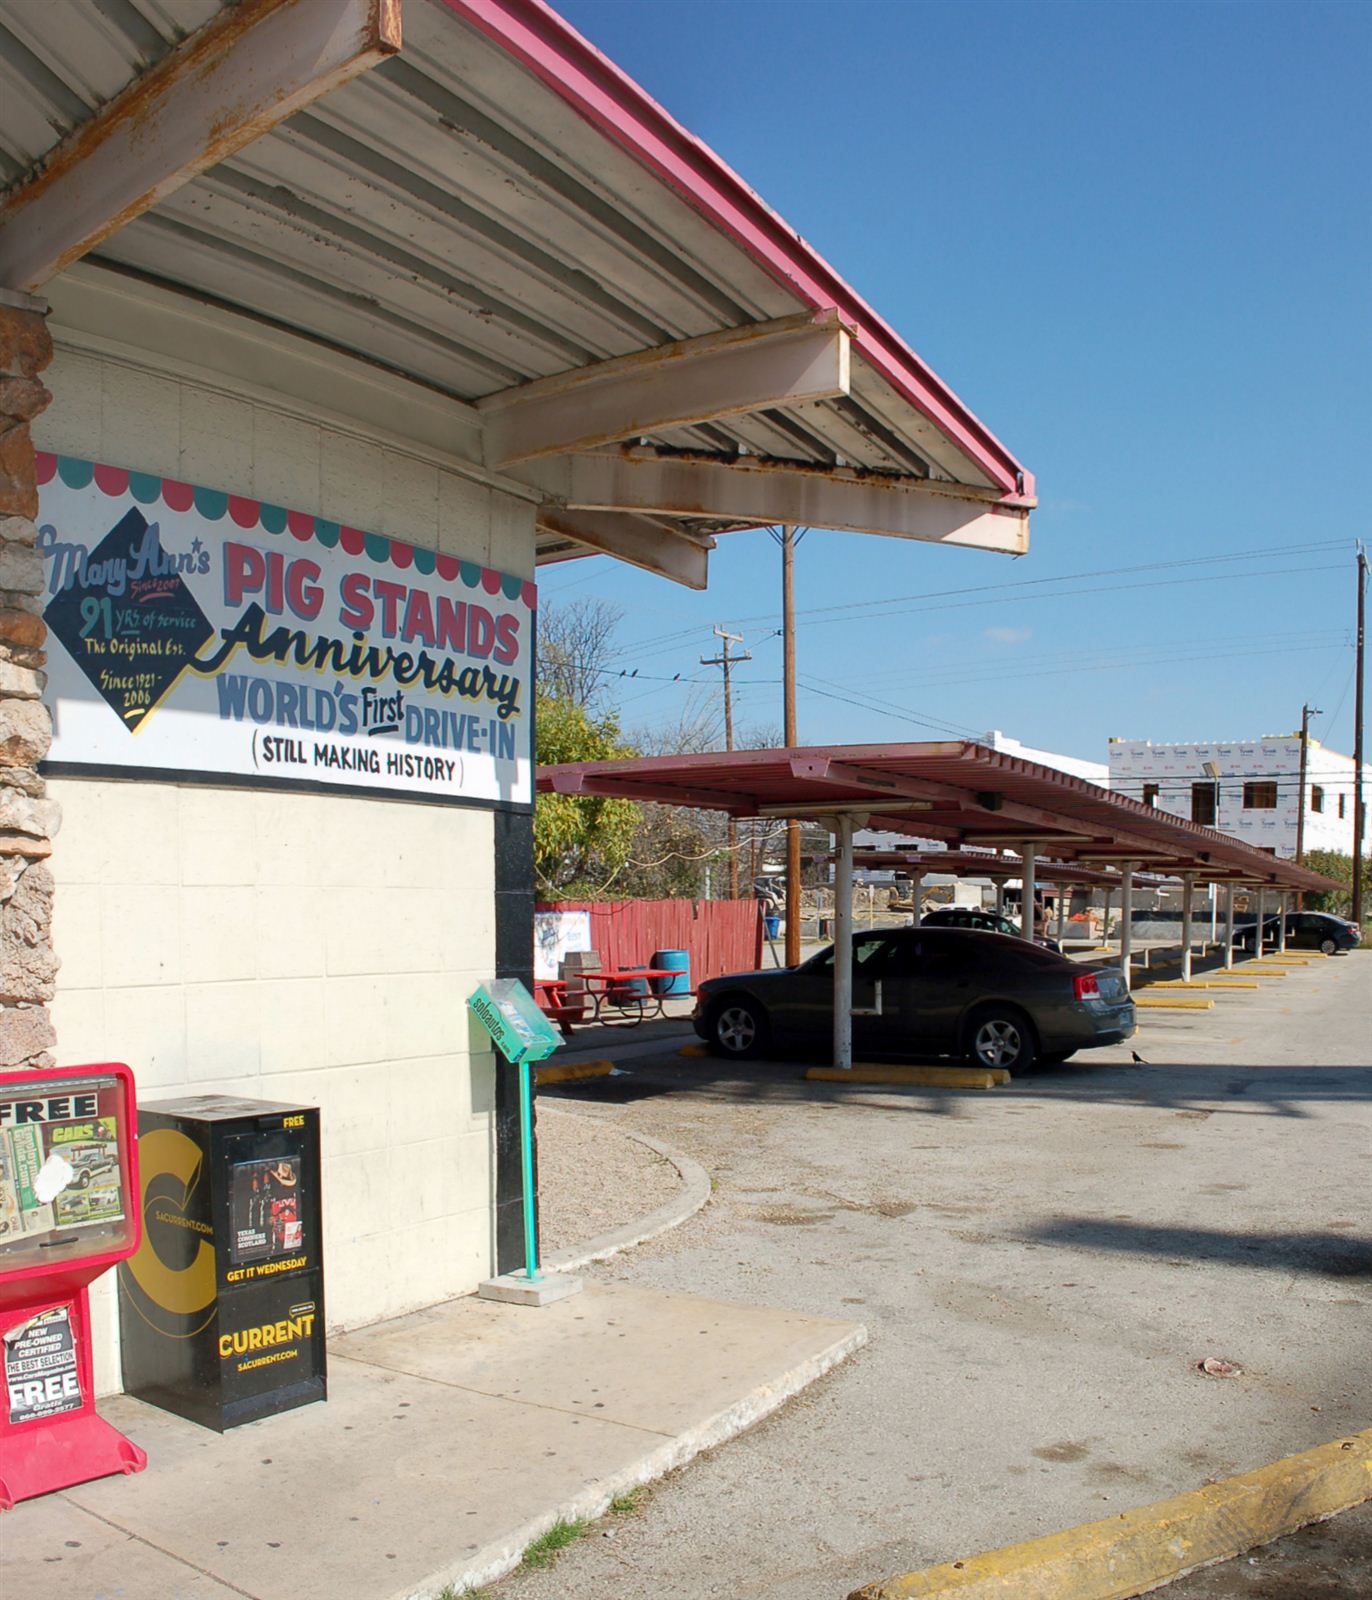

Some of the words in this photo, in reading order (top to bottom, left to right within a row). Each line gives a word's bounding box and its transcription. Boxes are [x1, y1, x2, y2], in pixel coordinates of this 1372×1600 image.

[223, 541, 324, 622] PIG
[339, 572, 520, 666] STANDS
[78, 596, 113, 639] 91
[143, 610, 155, 629] of
[84, 638, 106, 655] The
[110, 637, 162, 661] Original
[190, 600, 522, 721] Anniversary
[100, 669, 134, 690] Since
[123, 690, 151, 707] 2006
[216, 672, 359, 737] WORLD'S
[361, 686, 404, 727] First
[405, 704, 516, 761] DRIVE-IN
[314, 742, 379, 774] MAKING
[473, 998, 505, 1041] soloautos
[52, 1124, 94, 1143] CARS
[283, 1114, 305, 1129] FREE
[155, 1210, 214, 1236] SACURRENT.COM
[227, 1269, 245, 1282] GET
[246, 1267, 255, 1278] IT
[256, 1256, 308, 1275] WEDNESDAY
[14, 1333, 63, 1350] PRE-OWNED
[28, 1327, 48, 1338] NEW
[219, 1314, 315, 1358] CURRENT
[7, 1362, 20, 1373] THE
[21, 1359, 39, 1371] BEST
[41, 1352, 74, 1367] SELECTION
[18, 1342, 62, 1358] CERTIFIED
[237, 1349, 298, 1372] SACURRENT.COM
[9, 1371, 80, 1410] FREE
